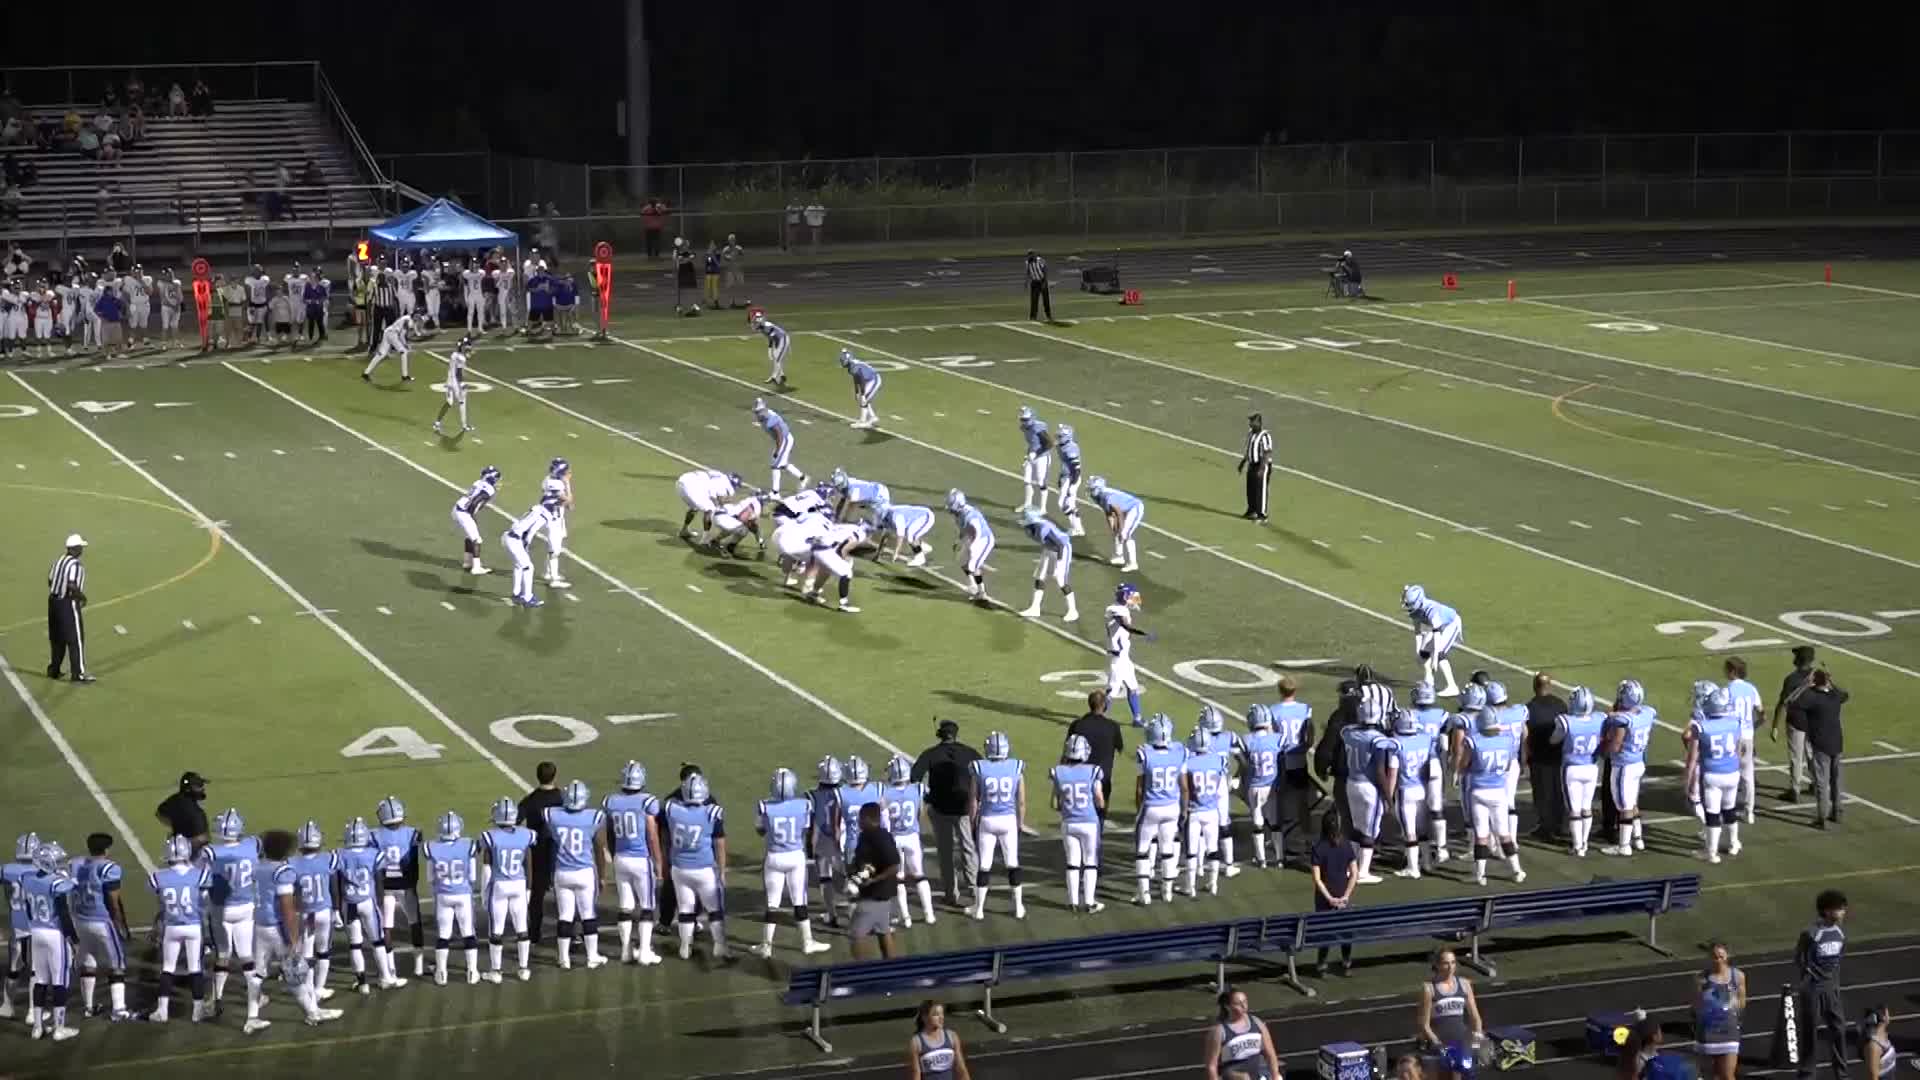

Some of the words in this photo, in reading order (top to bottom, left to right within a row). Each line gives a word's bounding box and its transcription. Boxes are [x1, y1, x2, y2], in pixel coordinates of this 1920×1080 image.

[358, 243, 369, 260] 2
[1653, 610, 1893, 650] 20
[339, 714, 601, 760] 40
[1710, 732, 1736, 759] 54
[773, 816, 797, 844] 51
[163, 886, 193, 916] 24
[1784, 995, 1799, 1063] SHARKS
